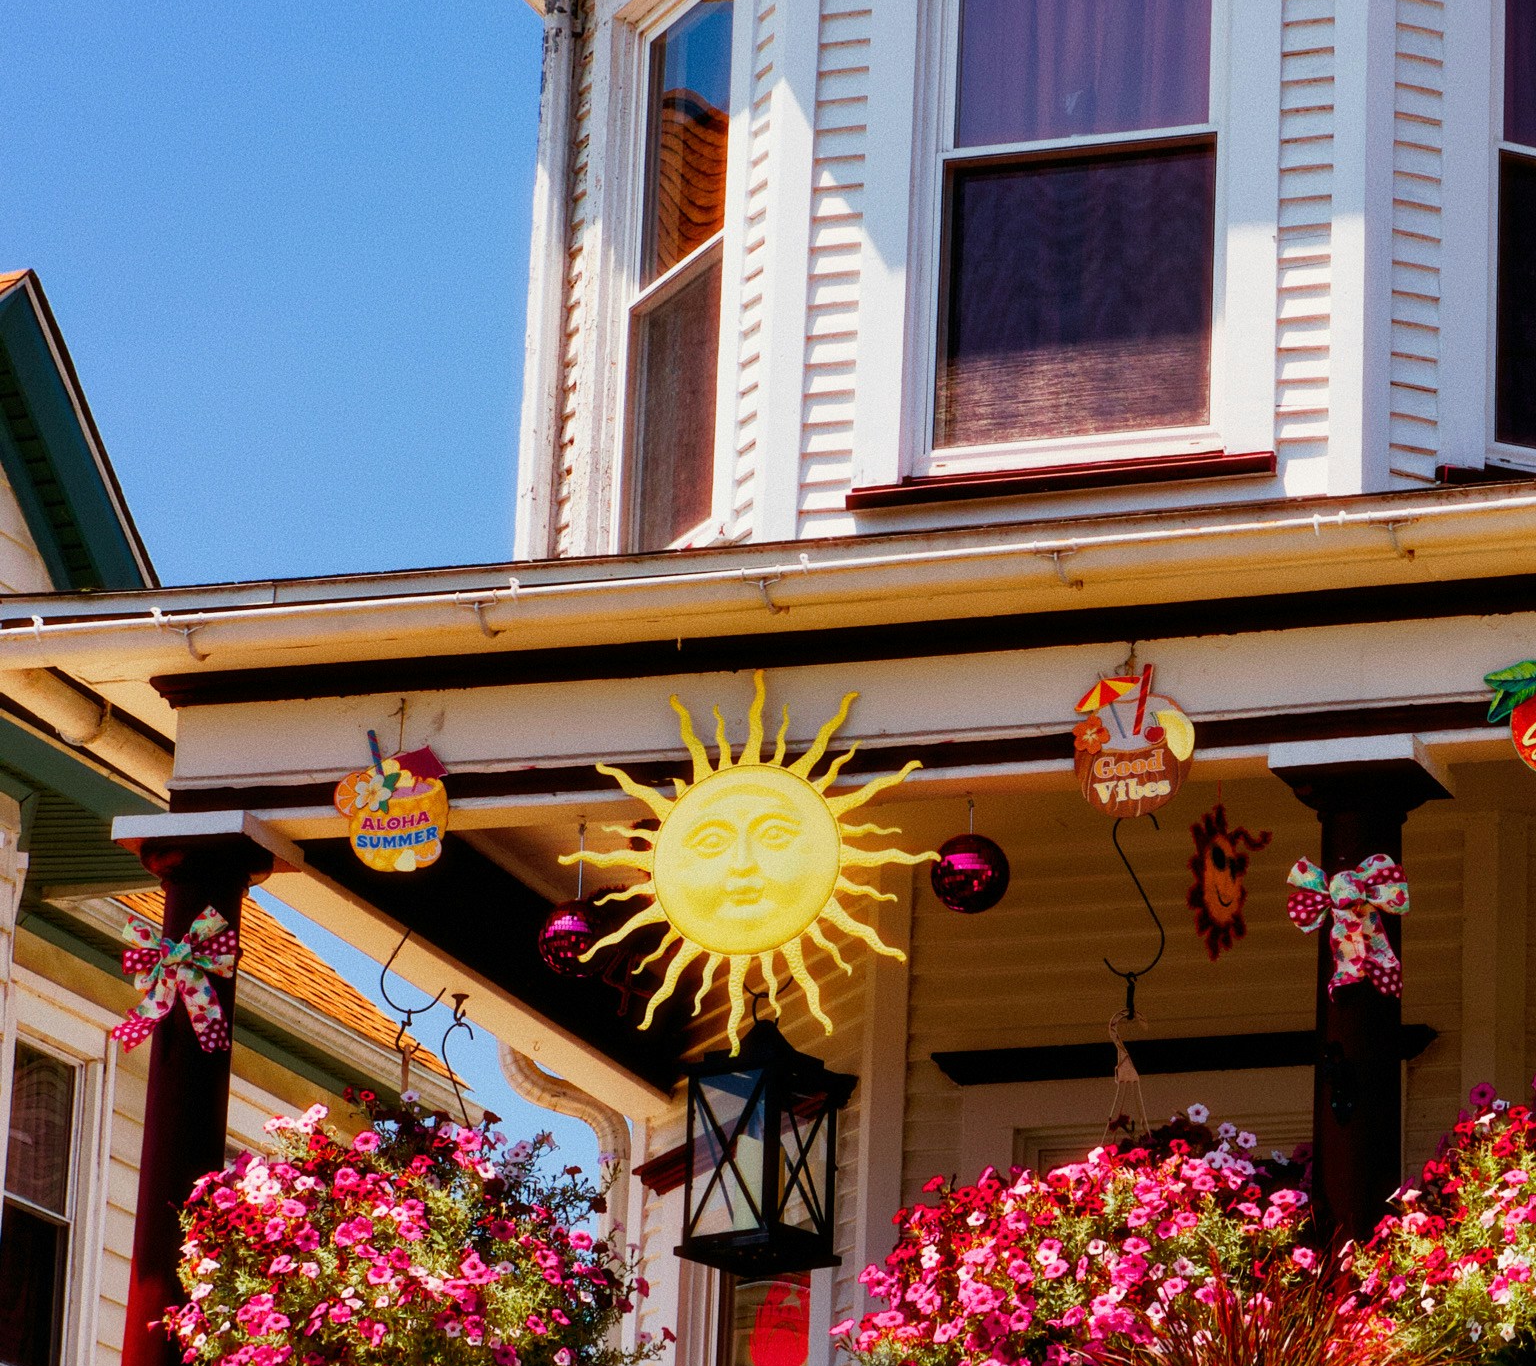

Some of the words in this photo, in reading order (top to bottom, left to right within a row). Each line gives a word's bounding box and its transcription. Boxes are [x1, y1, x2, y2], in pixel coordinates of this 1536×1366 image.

[1094, 748, 1165, 778] Good
[1093, 779, 1171, 804] Vibes
[361, 811, 430, 830] ALOHA
[356, 826, 438, 848] SUMMER
